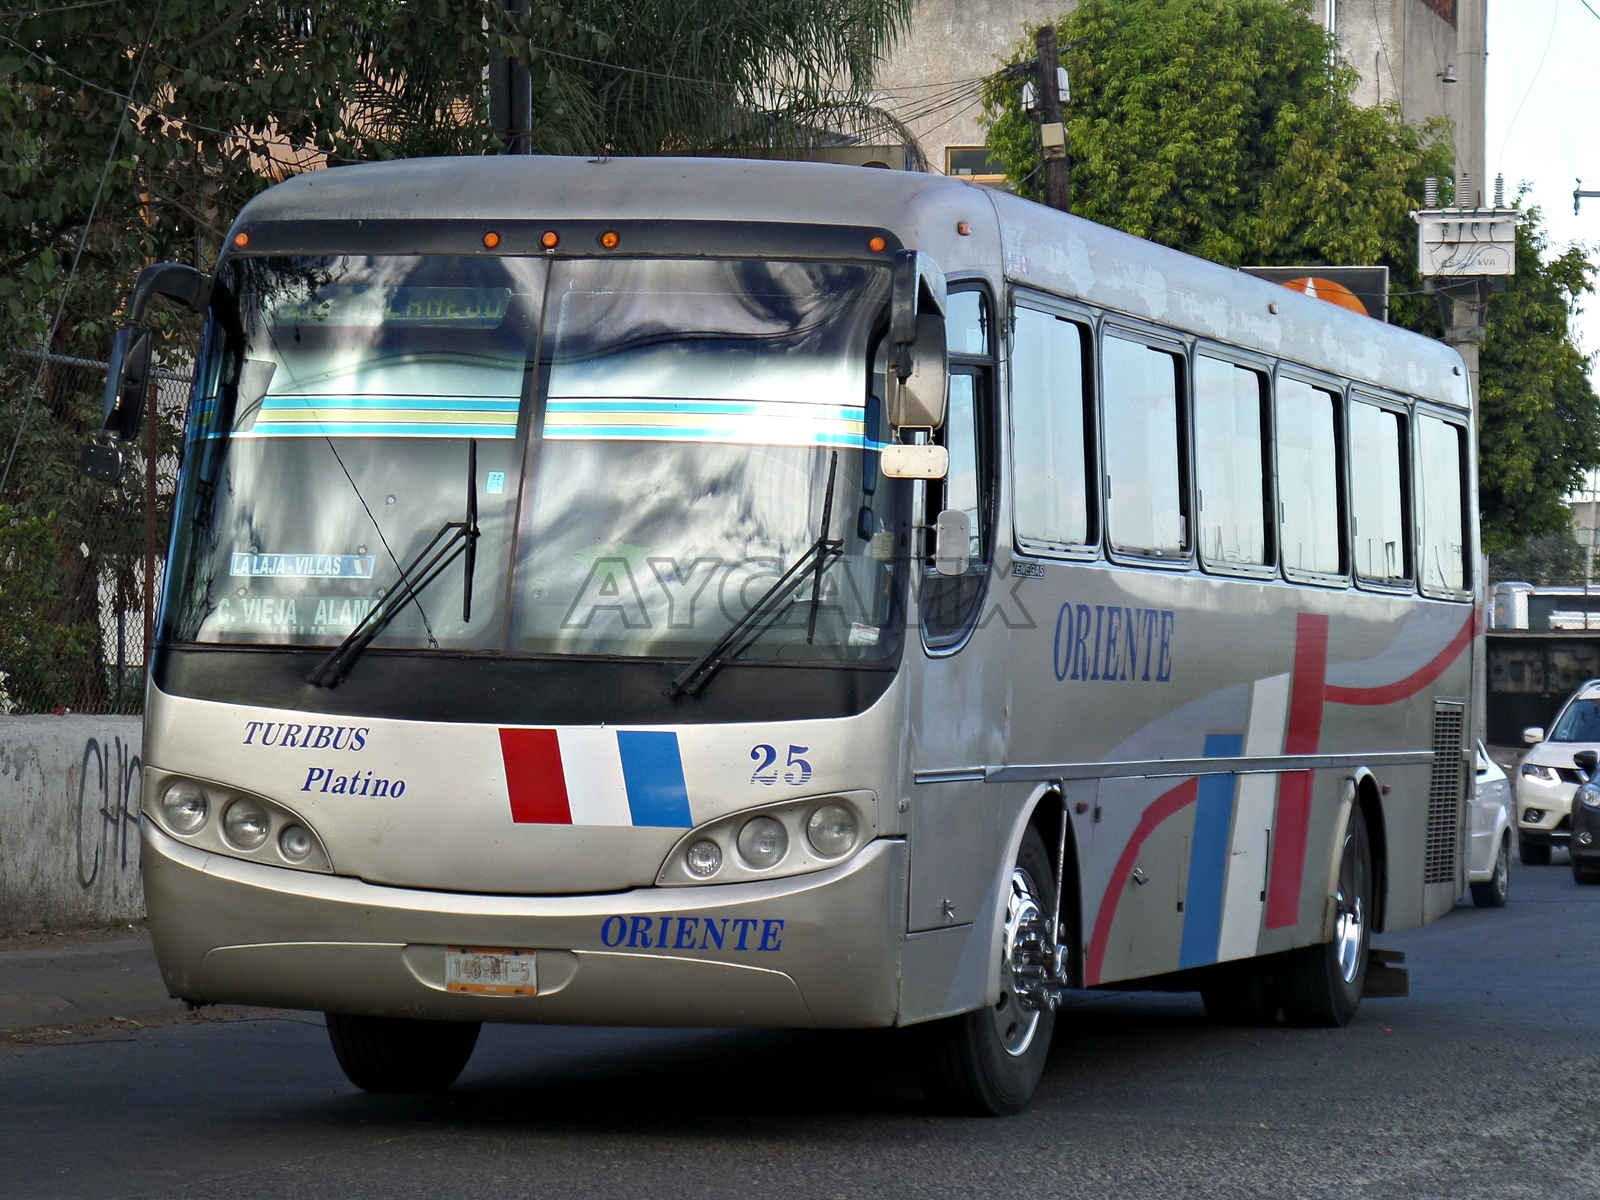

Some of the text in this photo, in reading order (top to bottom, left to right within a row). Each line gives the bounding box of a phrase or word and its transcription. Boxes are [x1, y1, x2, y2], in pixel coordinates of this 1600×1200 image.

[295, 557, 342, 575] VILLAS
[1012, 562, 1045, 577] VENEGAS
[242, 598, 297, 624] VIEJA
[1053, 601, 1175, 683] ORIENTE
[242, 721, 370, 751] TURIBUS
[749, 743, 813, 786] 25
[300, 767, 406, 798] Platino
[600, 914, 785, 952] ORIENTE
